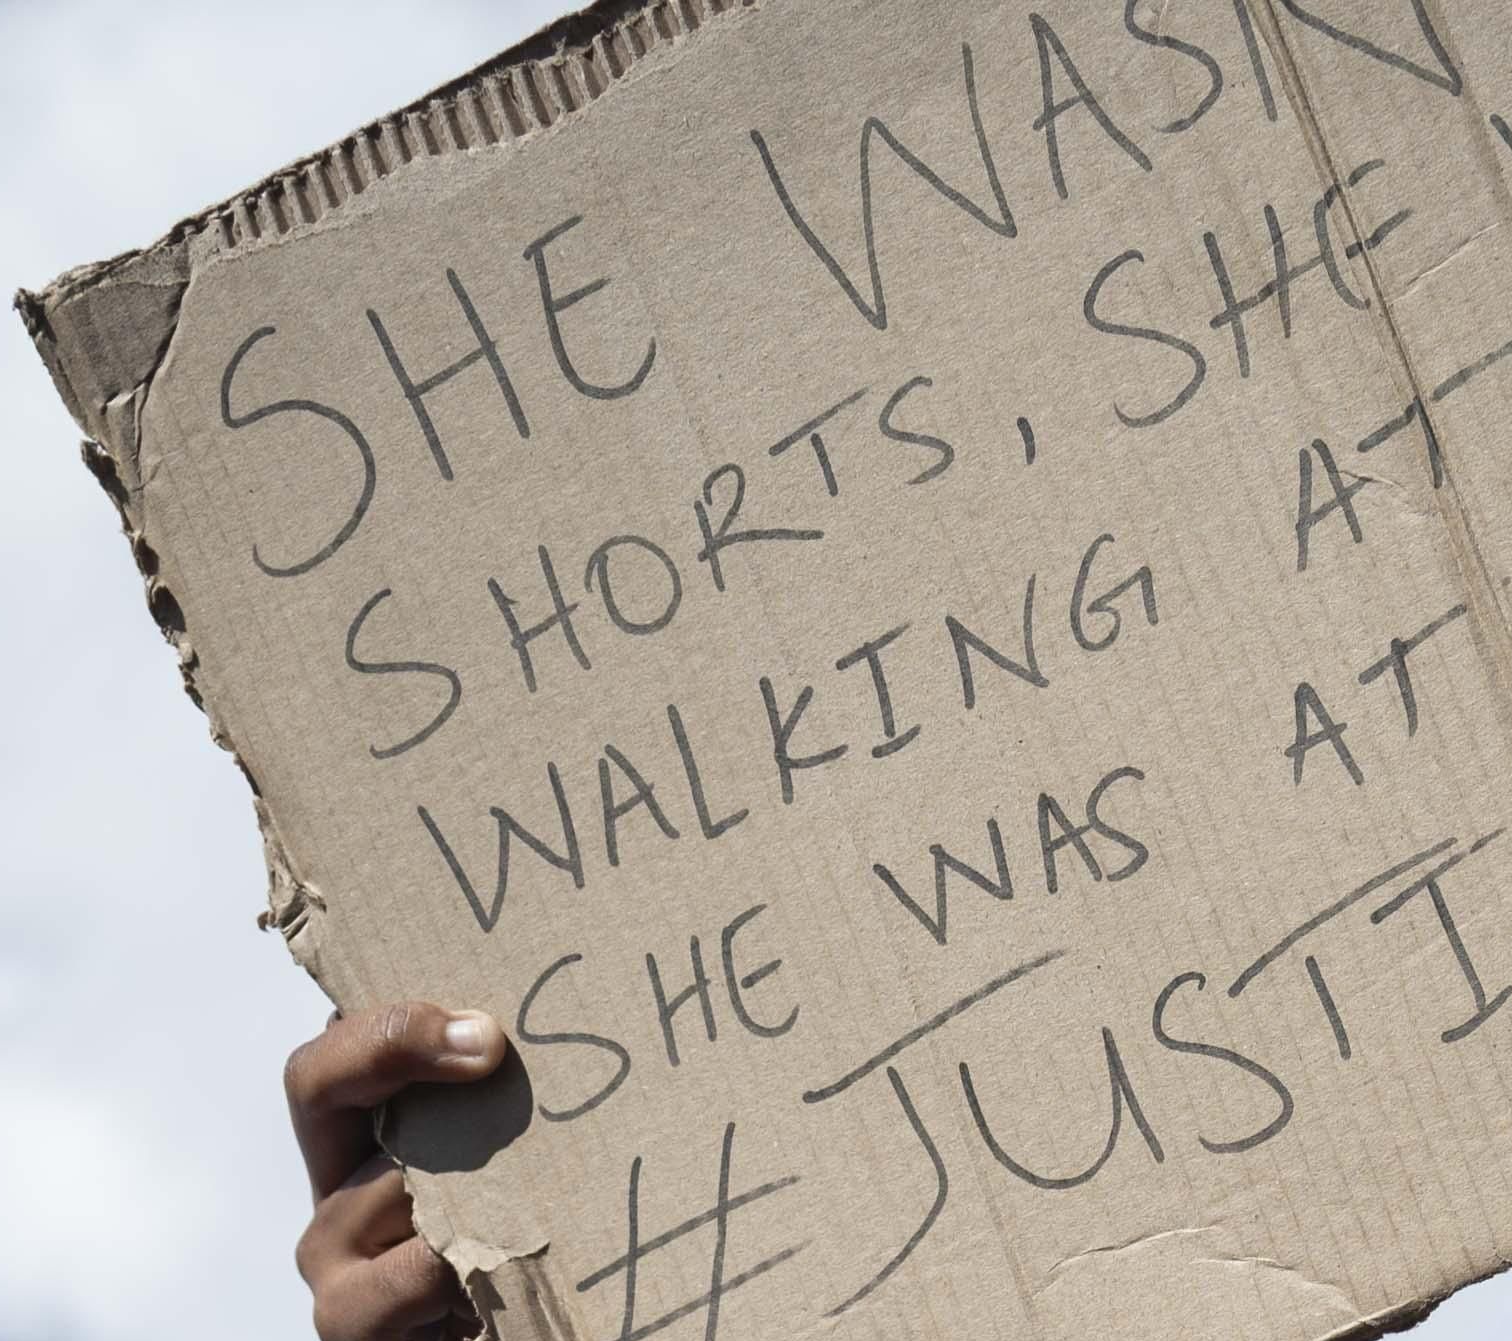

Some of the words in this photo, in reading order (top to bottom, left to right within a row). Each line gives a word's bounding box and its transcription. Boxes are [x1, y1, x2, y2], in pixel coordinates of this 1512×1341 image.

[221, 214, 657, 577] SHE
[345, 376, 1037, 759] SHORTS,
[1083, 158, 1416, 428] SHE
[417, 532, 1160, 932] WALKING
[515, 903, 800, 1123] SHE
[872, 765, 1149, 945] WAS
[1284, 604, 1467, 787] AT
